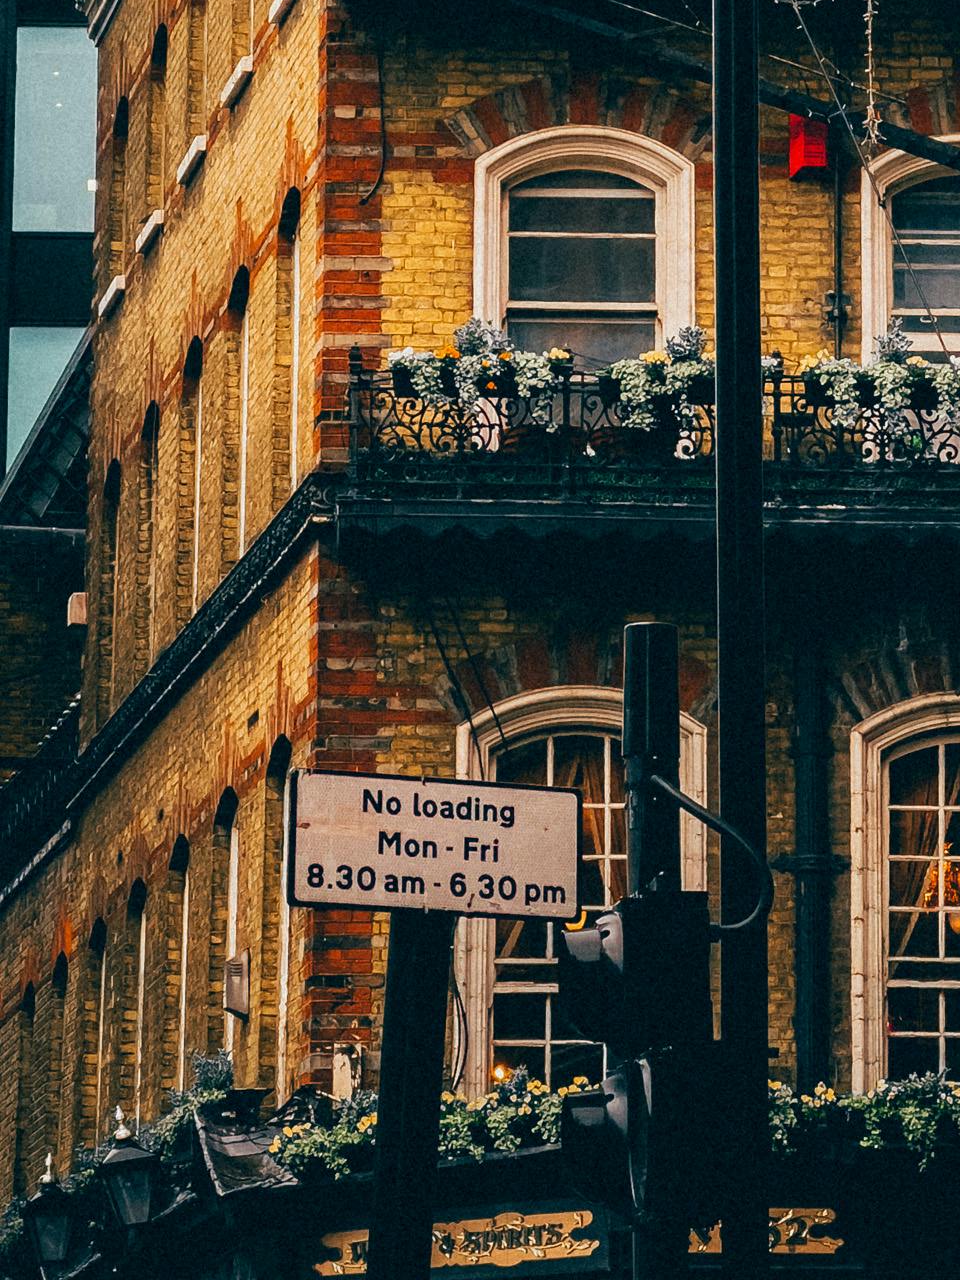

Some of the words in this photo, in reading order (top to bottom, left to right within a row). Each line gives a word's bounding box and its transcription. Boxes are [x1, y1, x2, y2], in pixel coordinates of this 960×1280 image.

[362, 789, 401, 815] No
[413, 793, 515, 828] loading
[378, 831, 438, 858] Mon
[464, 837, 499, 862] Fri
[307, 863, 376, 891] 8.30
[384, 874, 425, 894] am
[525, 882, 566, 906] pm
[463, 1223, 564, 1254] SPIRITS
